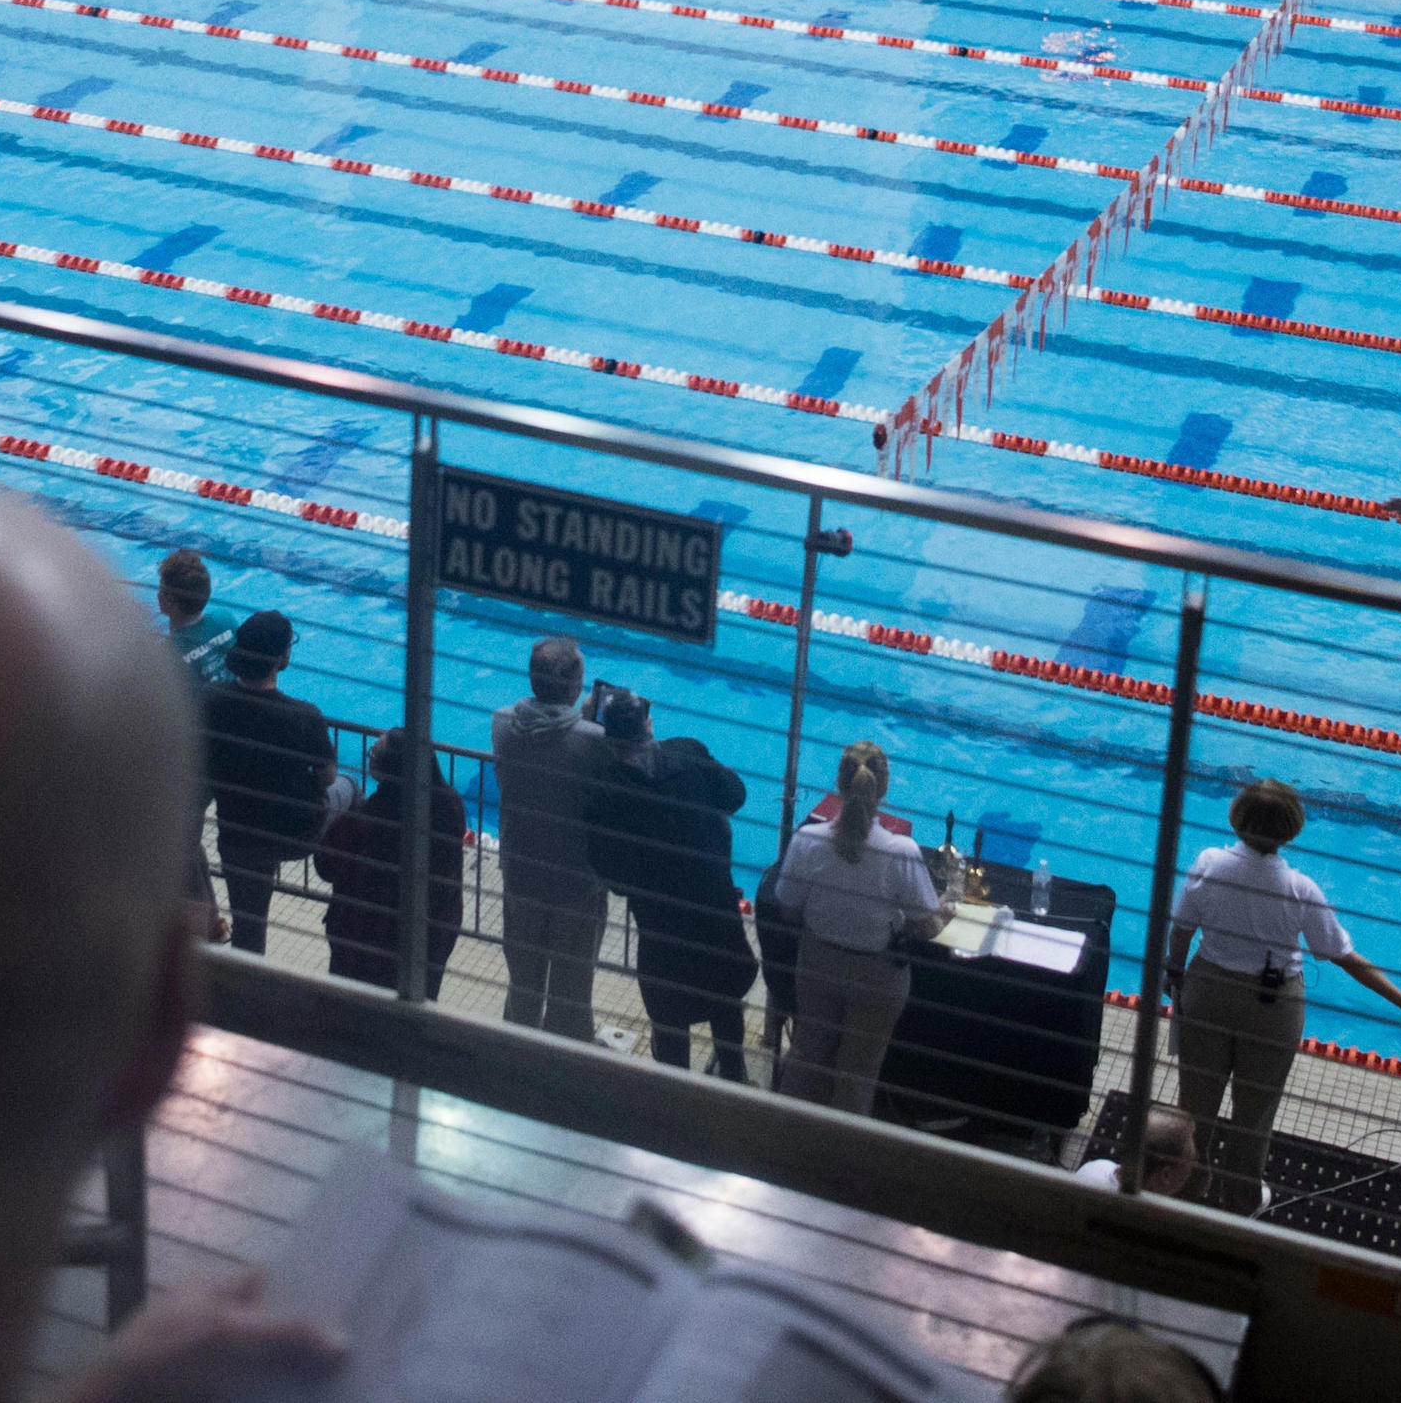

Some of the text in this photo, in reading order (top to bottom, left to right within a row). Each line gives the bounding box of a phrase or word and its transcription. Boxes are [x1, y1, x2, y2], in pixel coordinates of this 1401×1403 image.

[445, 482, 709, 577] NO STANDING
[445, 538, 701, 629] ALONG RAILS
